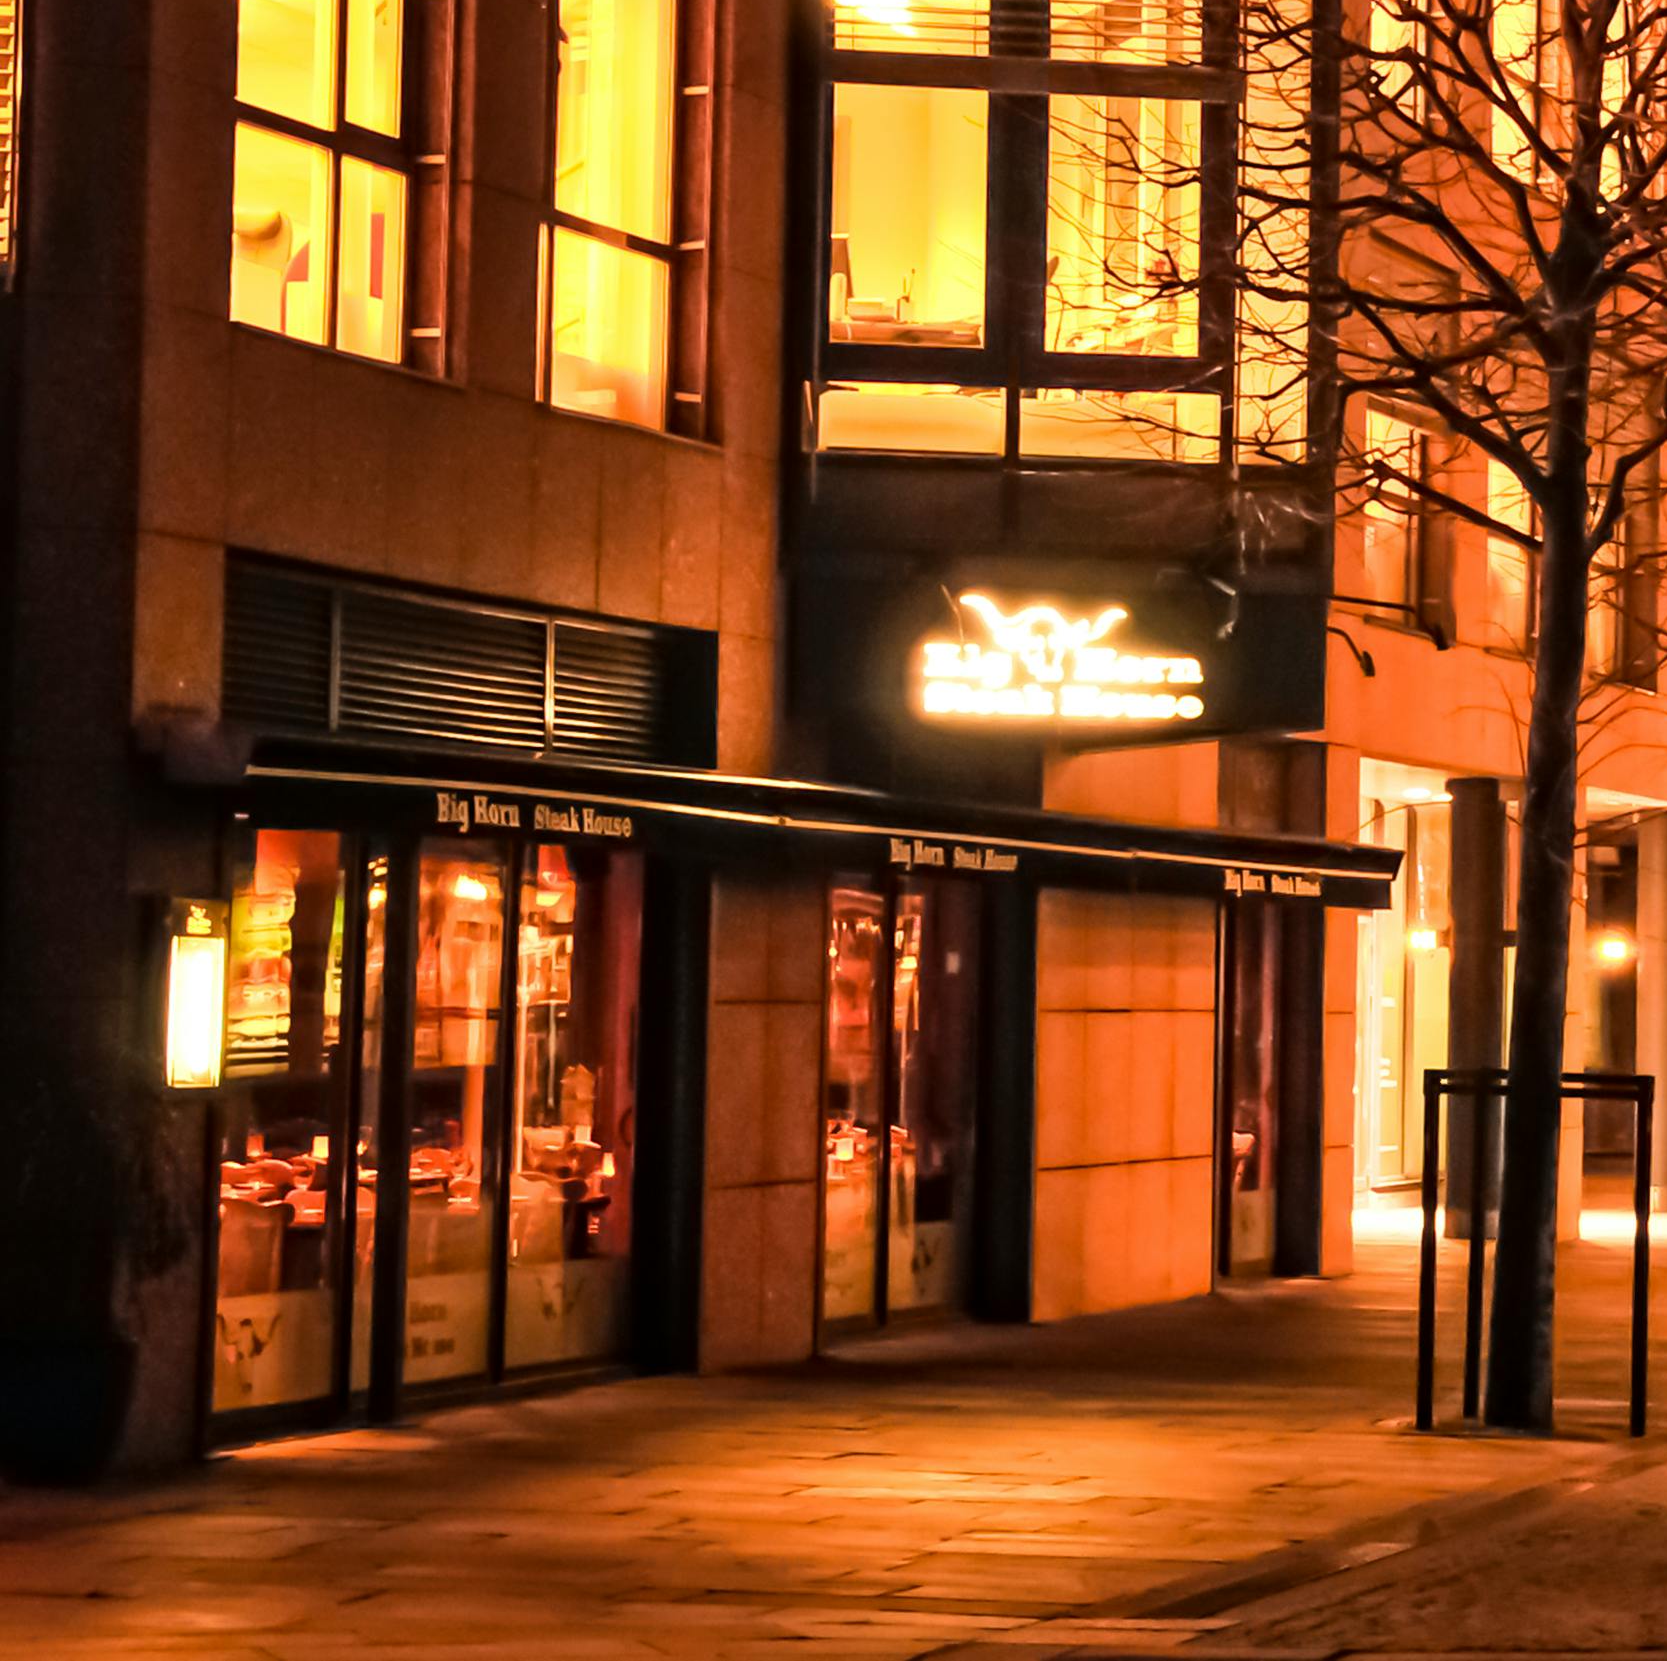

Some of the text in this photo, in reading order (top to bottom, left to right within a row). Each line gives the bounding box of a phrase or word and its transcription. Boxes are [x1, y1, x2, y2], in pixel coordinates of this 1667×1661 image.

[436, 792, 632, 837] Big Horn Steak House
